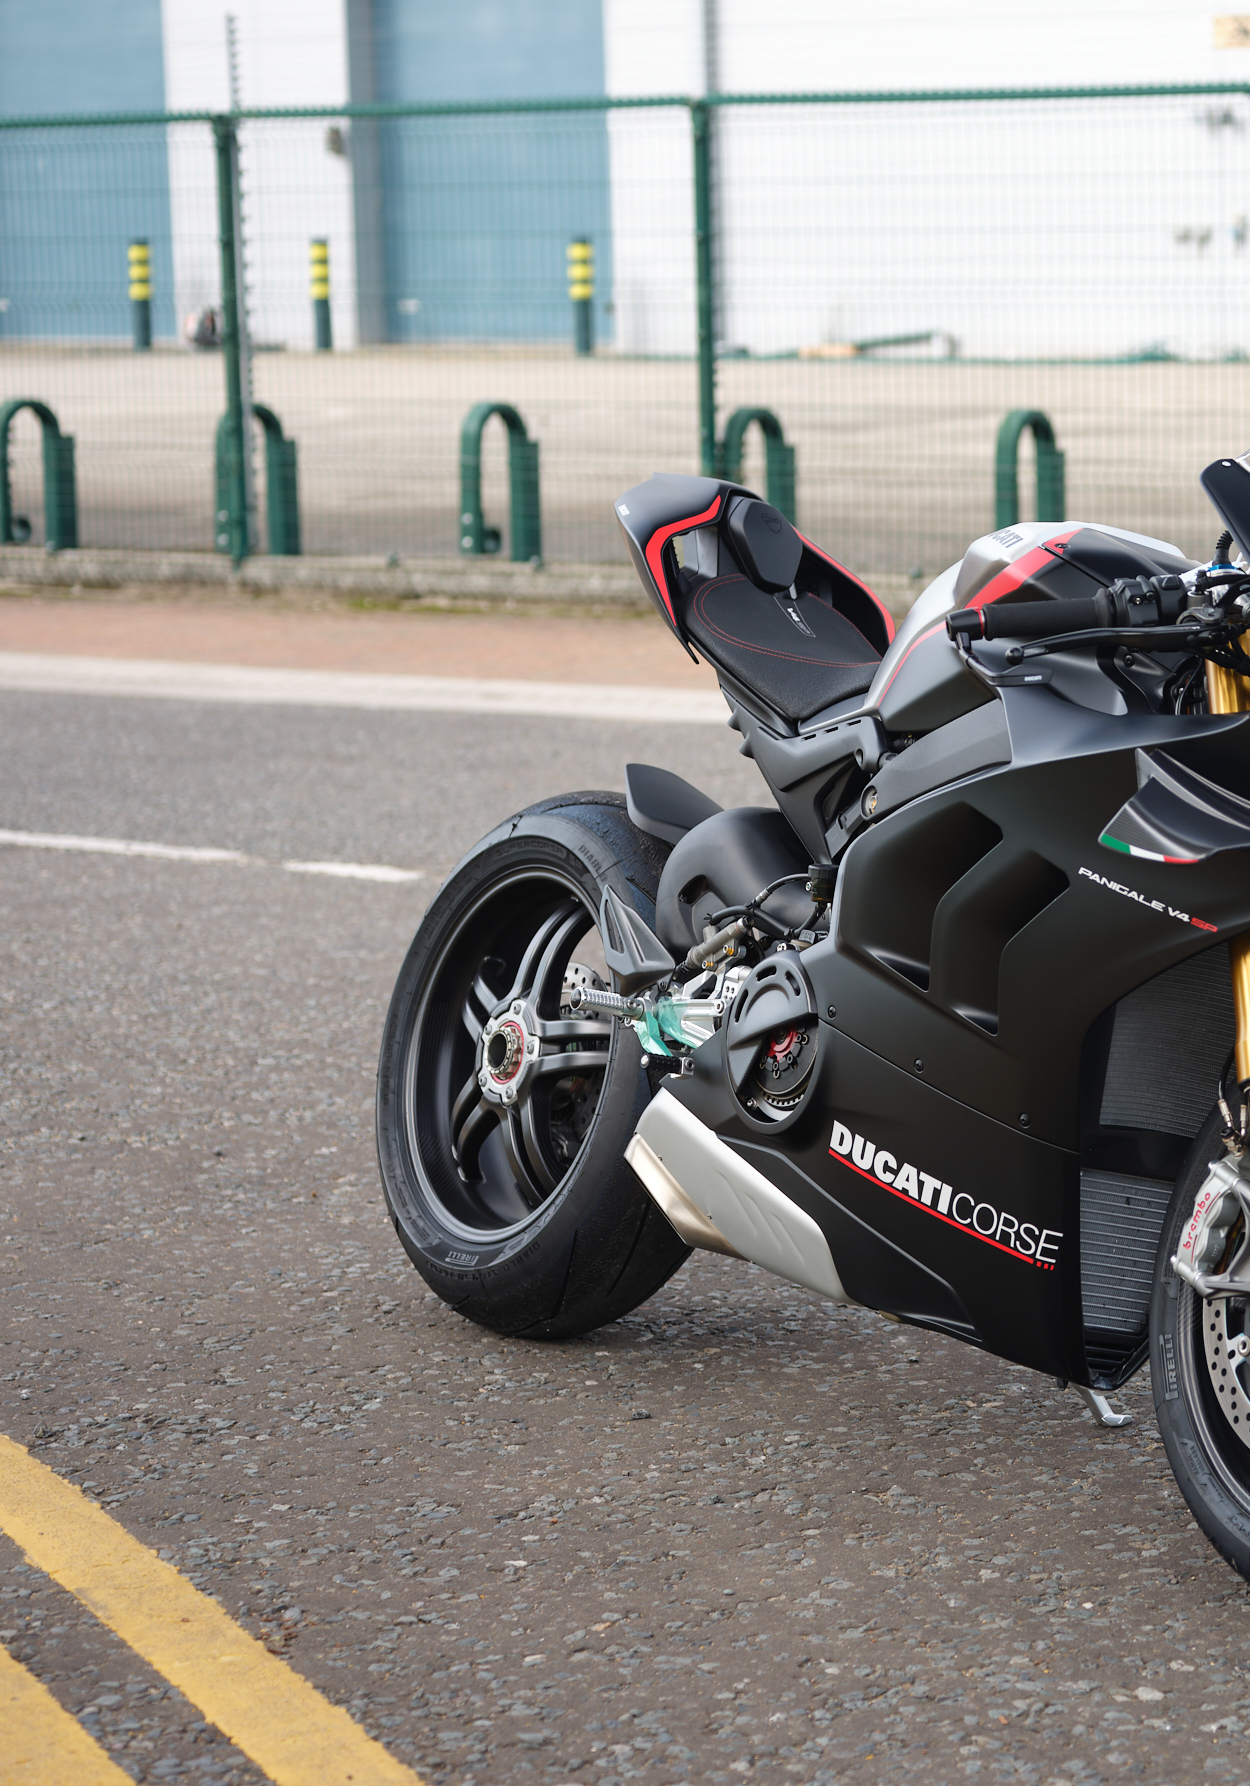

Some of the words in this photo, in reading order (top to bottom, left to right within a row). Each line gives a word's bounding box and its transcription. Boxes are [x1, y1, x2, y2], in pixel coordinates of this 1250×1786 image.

[495, 841, 563, 857] SUPERCORSA
[578, 844, 607, 882] DIABLO
[1078, 866, 1165, 912] PANIGALE
[1183, 1192, 1211, 1250] brembo
[445, 1251, 479, 1266] PIRELLI
[1159, 1333, 1178, 1400] PIRELLI
